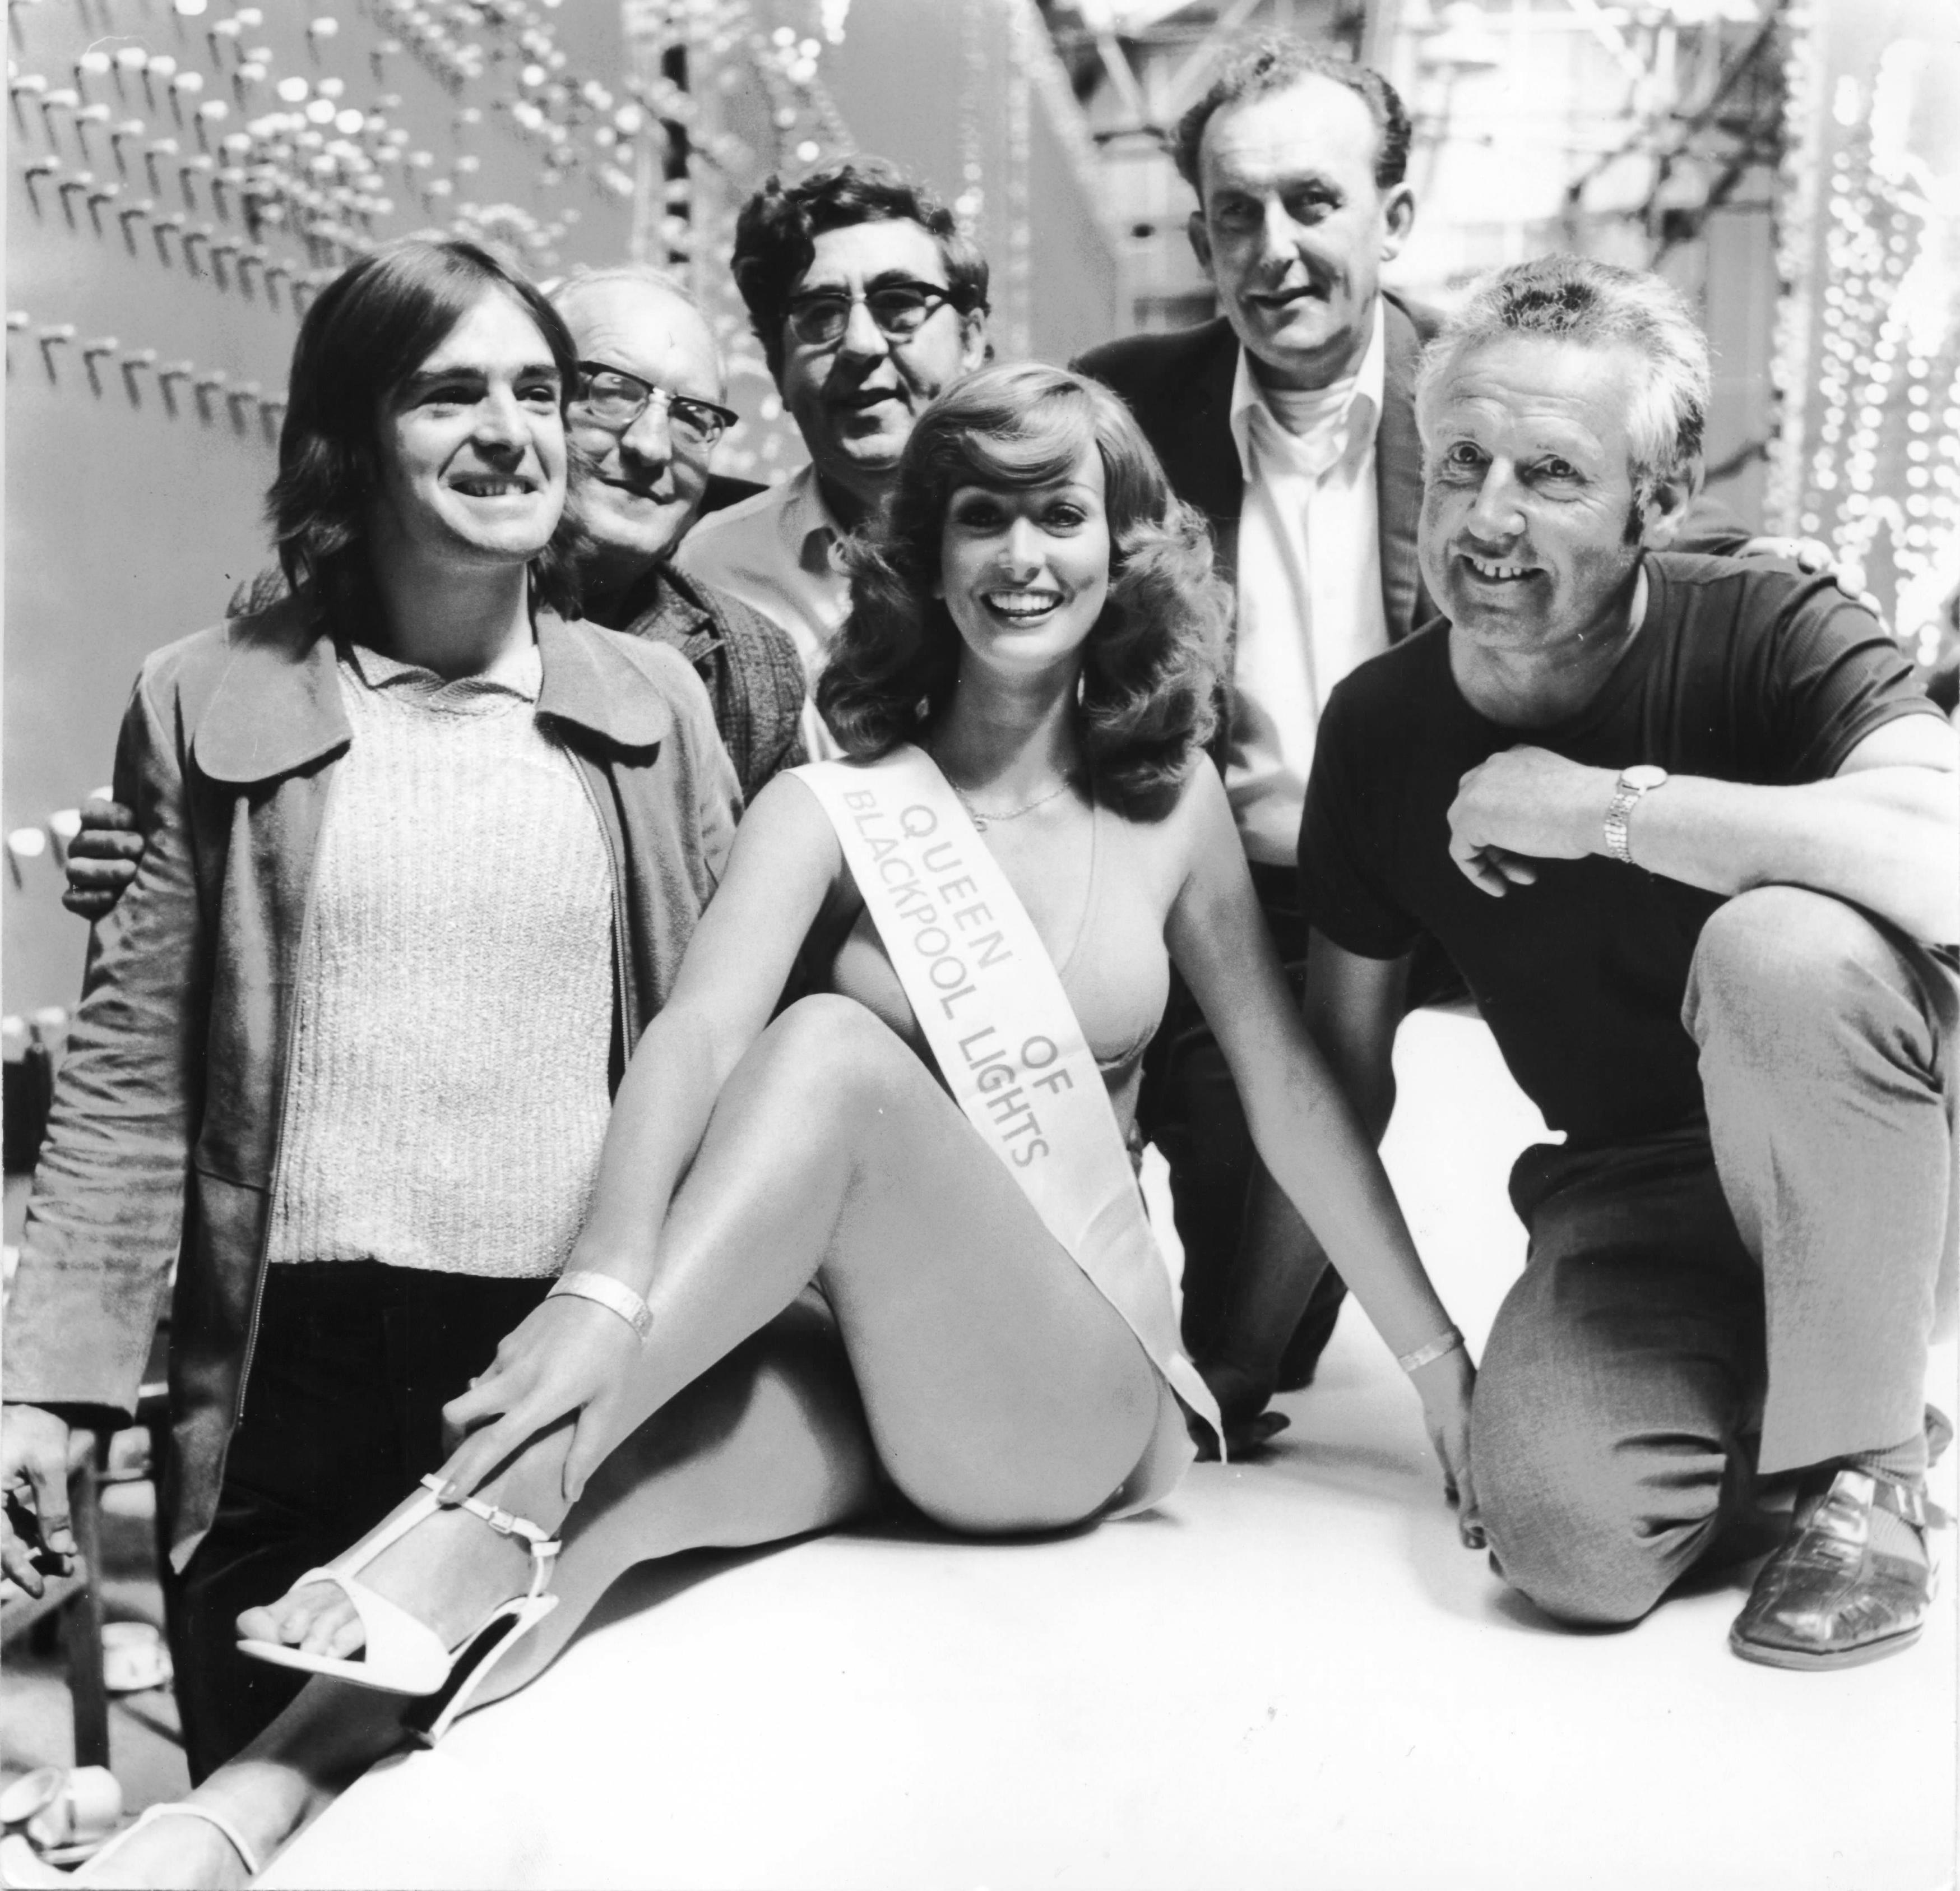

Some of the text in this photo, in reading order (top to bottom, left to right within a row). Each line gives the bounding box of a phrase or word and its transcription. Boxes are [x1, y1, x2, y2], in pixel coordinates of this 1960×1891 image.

[842, 789, 1049, 1168] BLACKPOOL LIGHTS
[900, 805, 1073, 1095] QUEEN OF
